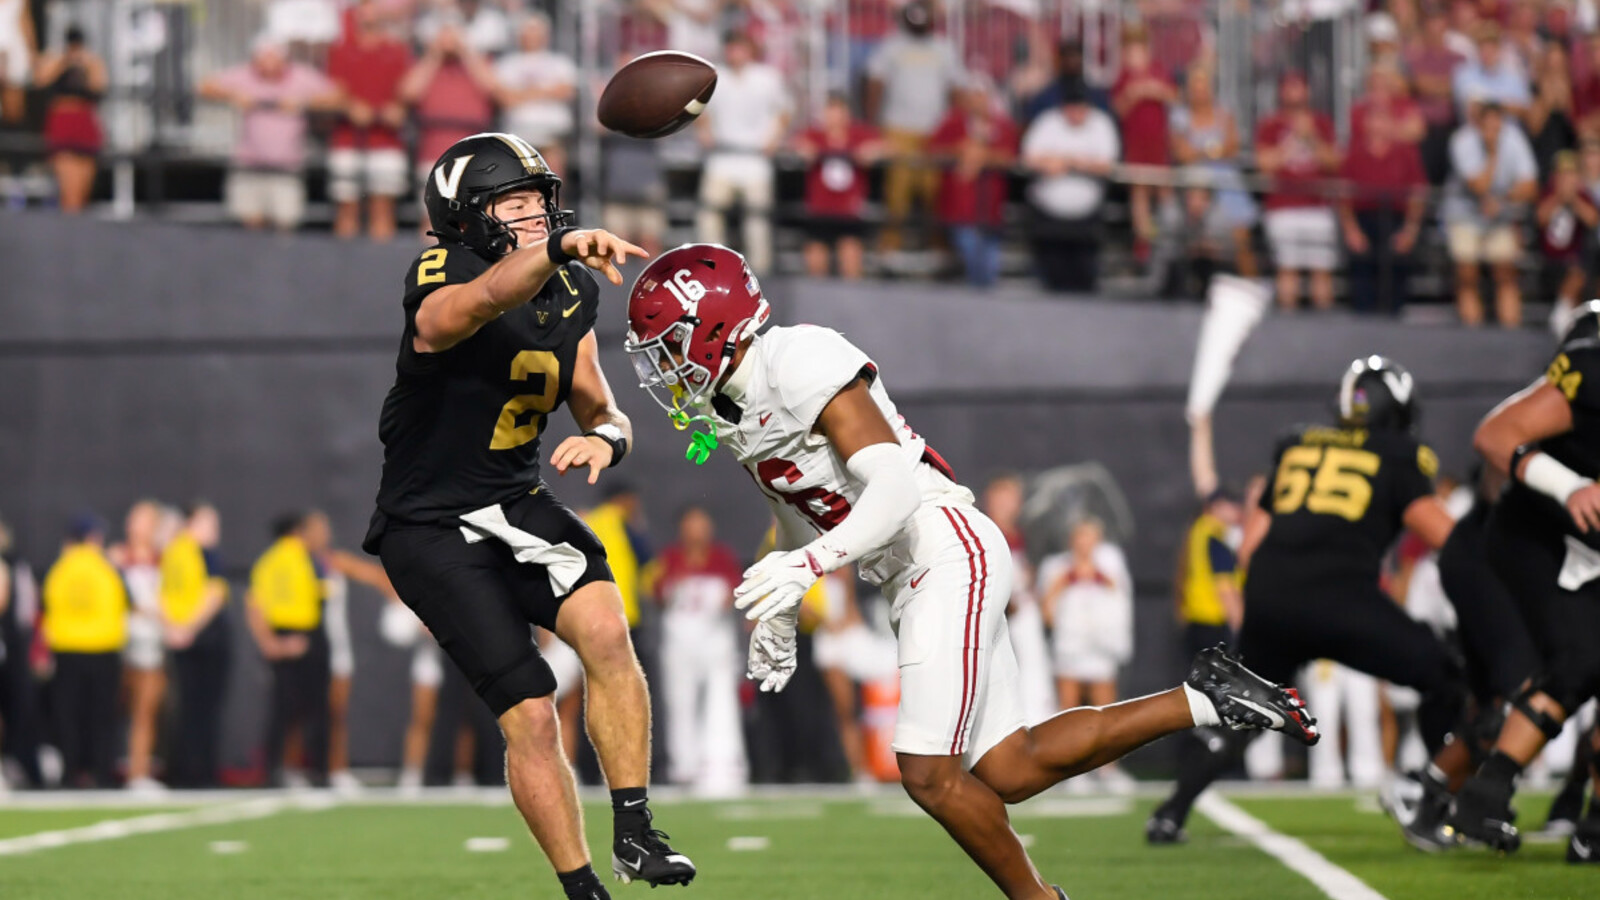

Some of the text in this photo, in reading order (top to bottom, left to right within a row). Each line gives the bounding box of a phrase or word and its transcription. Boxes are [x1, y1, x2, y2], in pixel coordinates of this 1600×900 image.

[434, 154, 475, 201] V
[417, 248, 448, 286] 2
[662, 268, 707, 311] 16
[489, 350, 560, 450] 2
